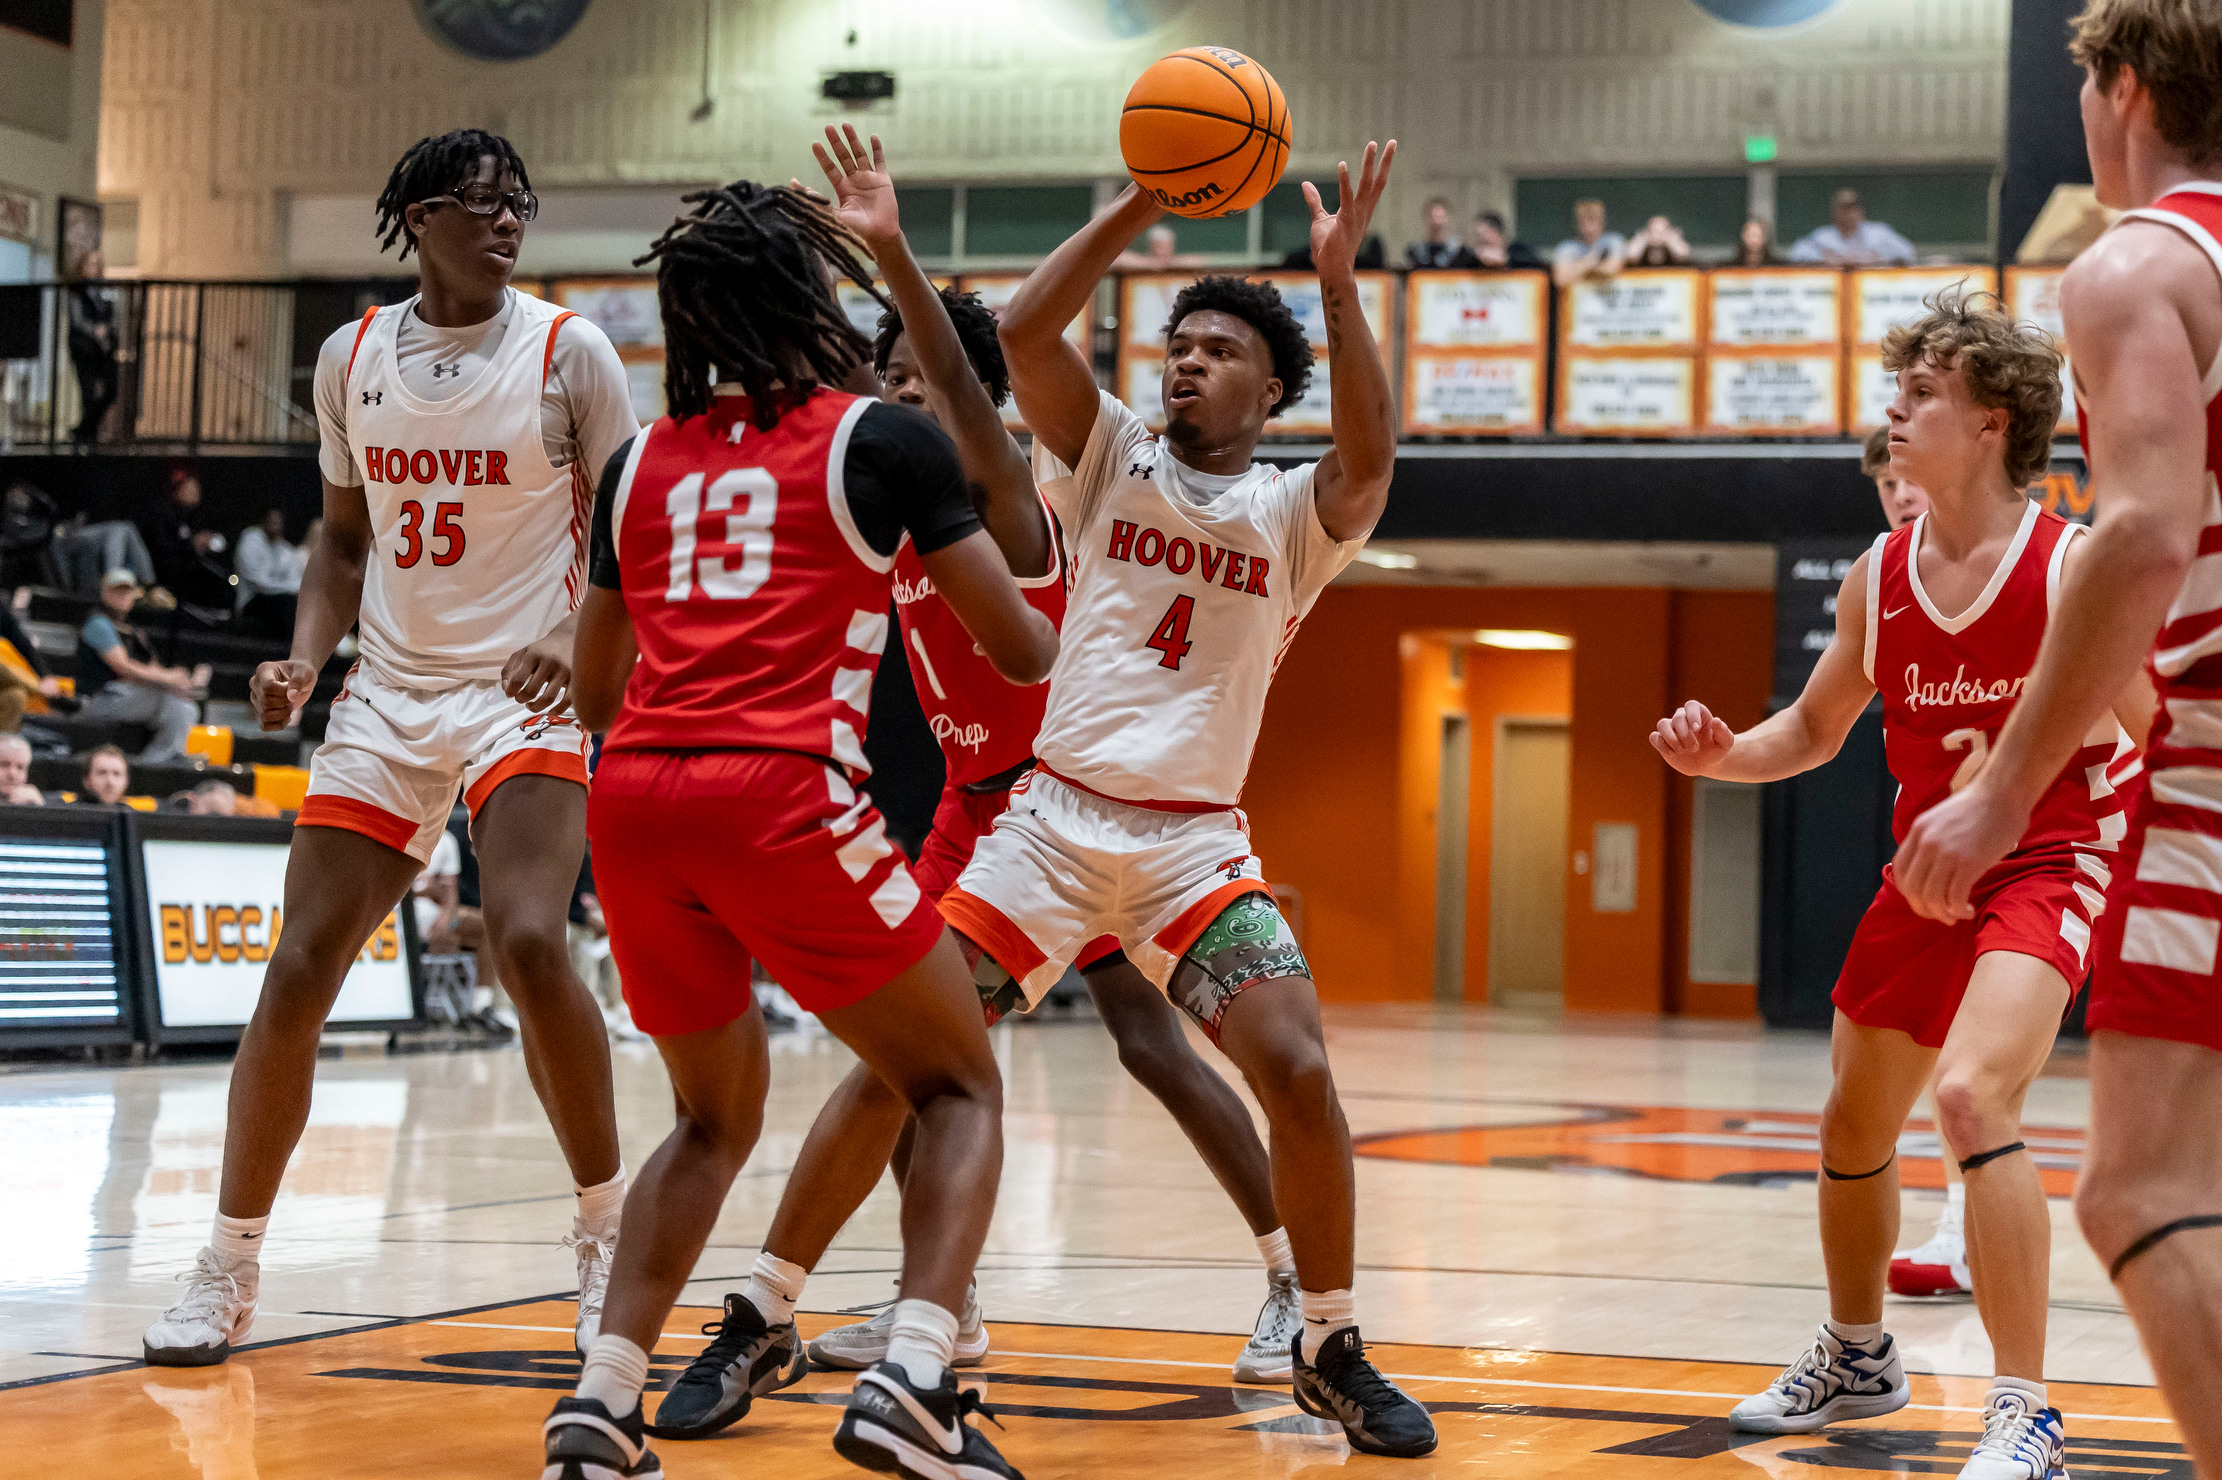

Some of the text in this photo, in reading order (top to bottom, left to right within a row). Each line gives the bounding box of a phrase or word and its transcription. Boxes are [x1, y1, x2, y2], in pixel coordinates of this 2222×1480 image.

[365, 446, 511, 486] HOOVER
[394, 500, 466, 569] 35
[665, 467, 779, 603] 13
[1107, 519, 1269, 598] HOOVER
[910, 627, 948, 701] 1
[1145, 593, 1195, 671] 4
[1904, 662, 2030, 713] Jackson
[929, 713, 990, 755] Prep
